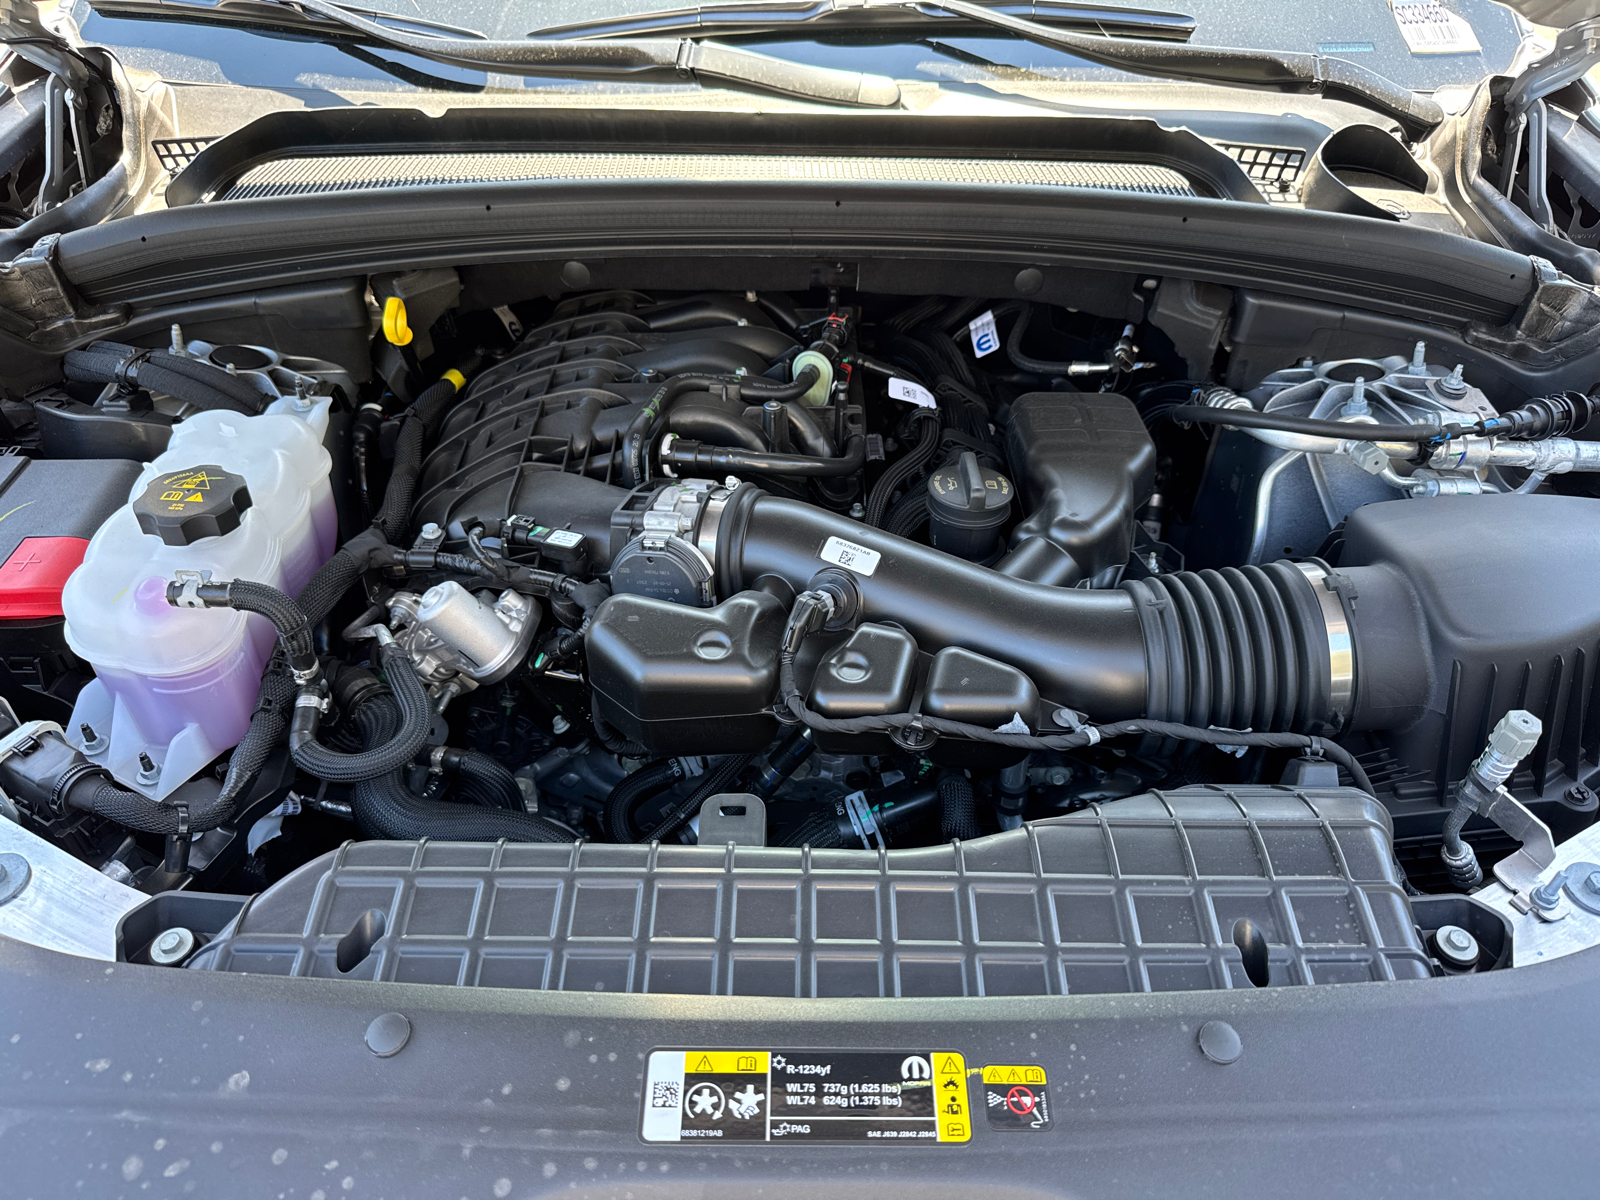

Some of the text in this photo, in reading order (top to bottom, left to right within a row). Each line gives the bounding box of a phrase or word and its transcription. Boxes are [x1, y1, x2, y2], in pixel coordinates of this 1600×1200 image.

[668, 758, 682, 777] ENG
[786, 1064, 832, 1076] R-1234yf
[785, 1083, 902, 1095] WL75 737g (1.625 lbs)
[785, 1095, 903, 1107] WL74 624g (1.375 lbs)
[791, 1125, 811, 1134] PAG
